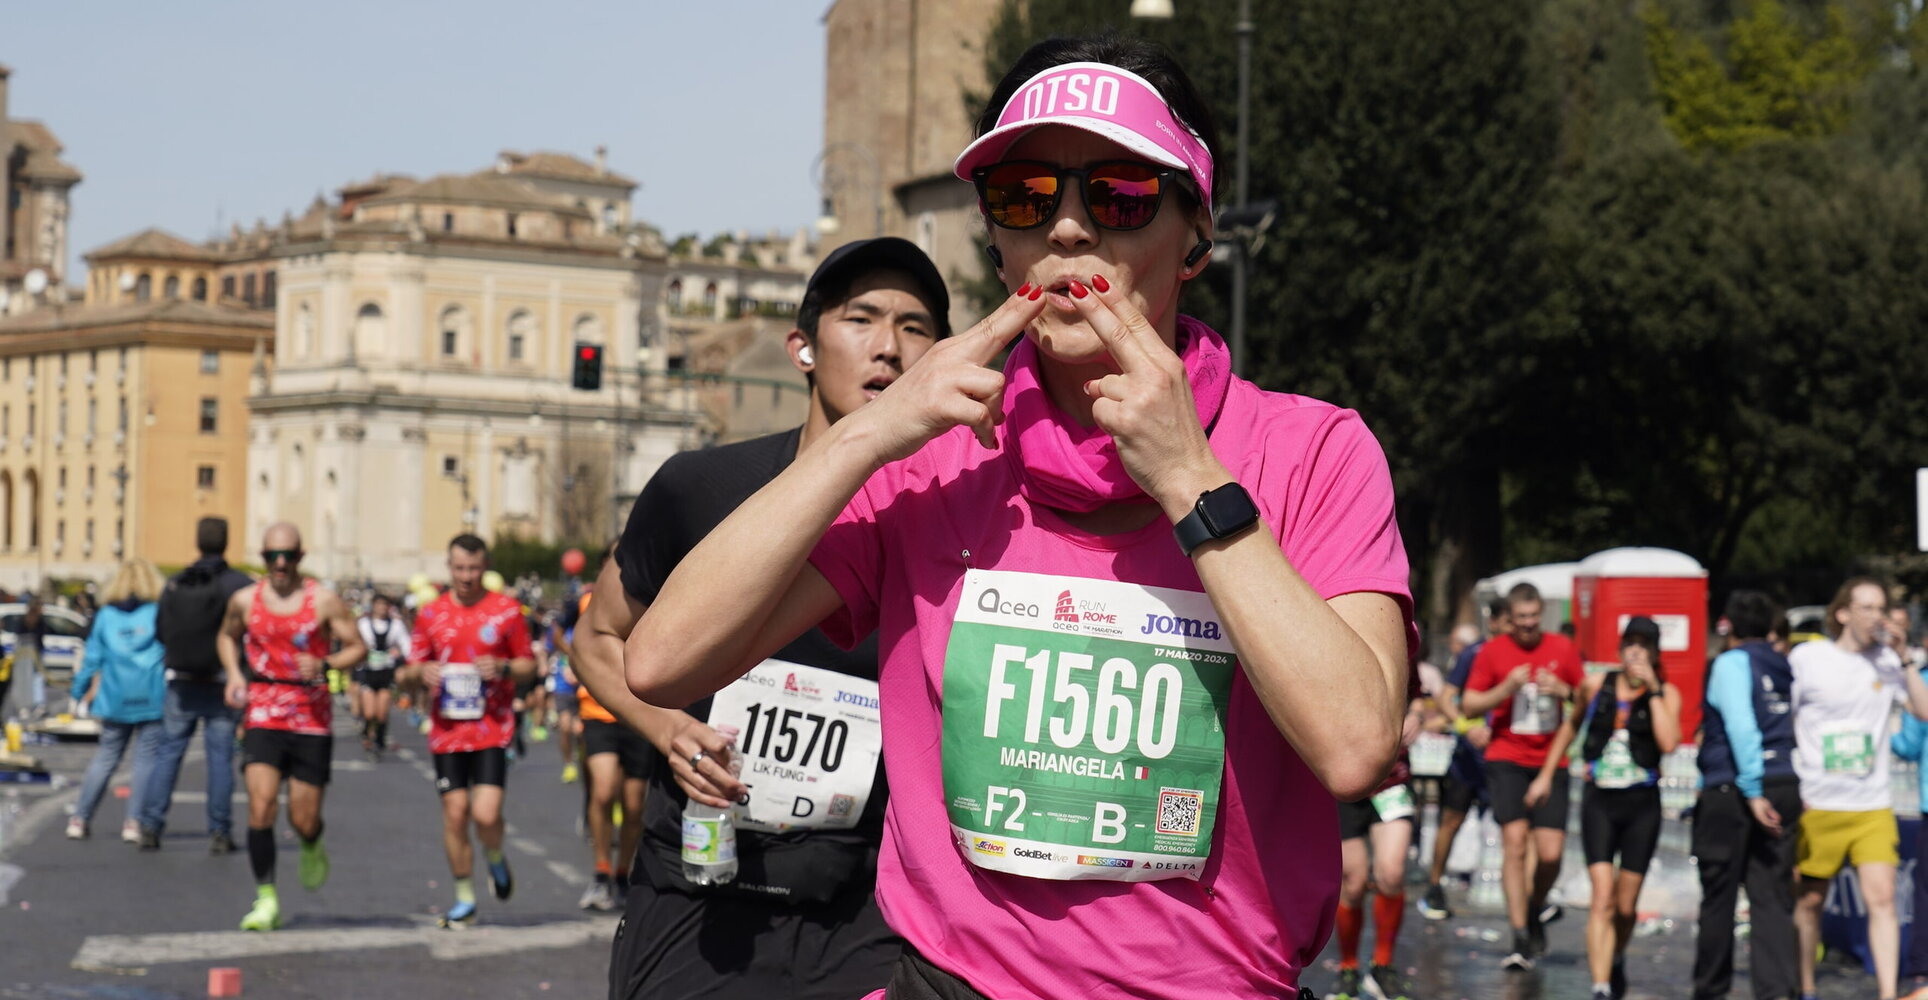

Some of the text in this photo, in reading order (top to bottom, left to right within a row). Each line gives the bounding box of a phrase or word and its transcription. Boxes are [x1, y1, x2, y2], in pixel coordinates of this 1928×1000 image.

[1023, 73, 1120, 120] OTSO
[1155, 120, 1176, 141] BORN
[978, 588, 1039, 618] acea
[1079, 600, 1107, 612] RUN
[1053, 622, 1079, 632] acea
[1083, 612, 1117, 624] ROME
[1154, 648, 1228, 664] 17 MARZO 2024
[984, 643, 1183, 759] F1560
[742, 702, 848, 773] 11570
[753, 762, 806, 782] LIK FUNG
[1001, 747, 1125, 780] MARIANGELA
[791, 796, 815, 817] D
[984, 785, 1027, 832] F2
[1092, 801, 1127, 844] B
[1083, 857, 1129, 867] MASSIGEN
[1156, 862, 1196, 870] DELTA
[738, 882, 792, 896] SALOMON
